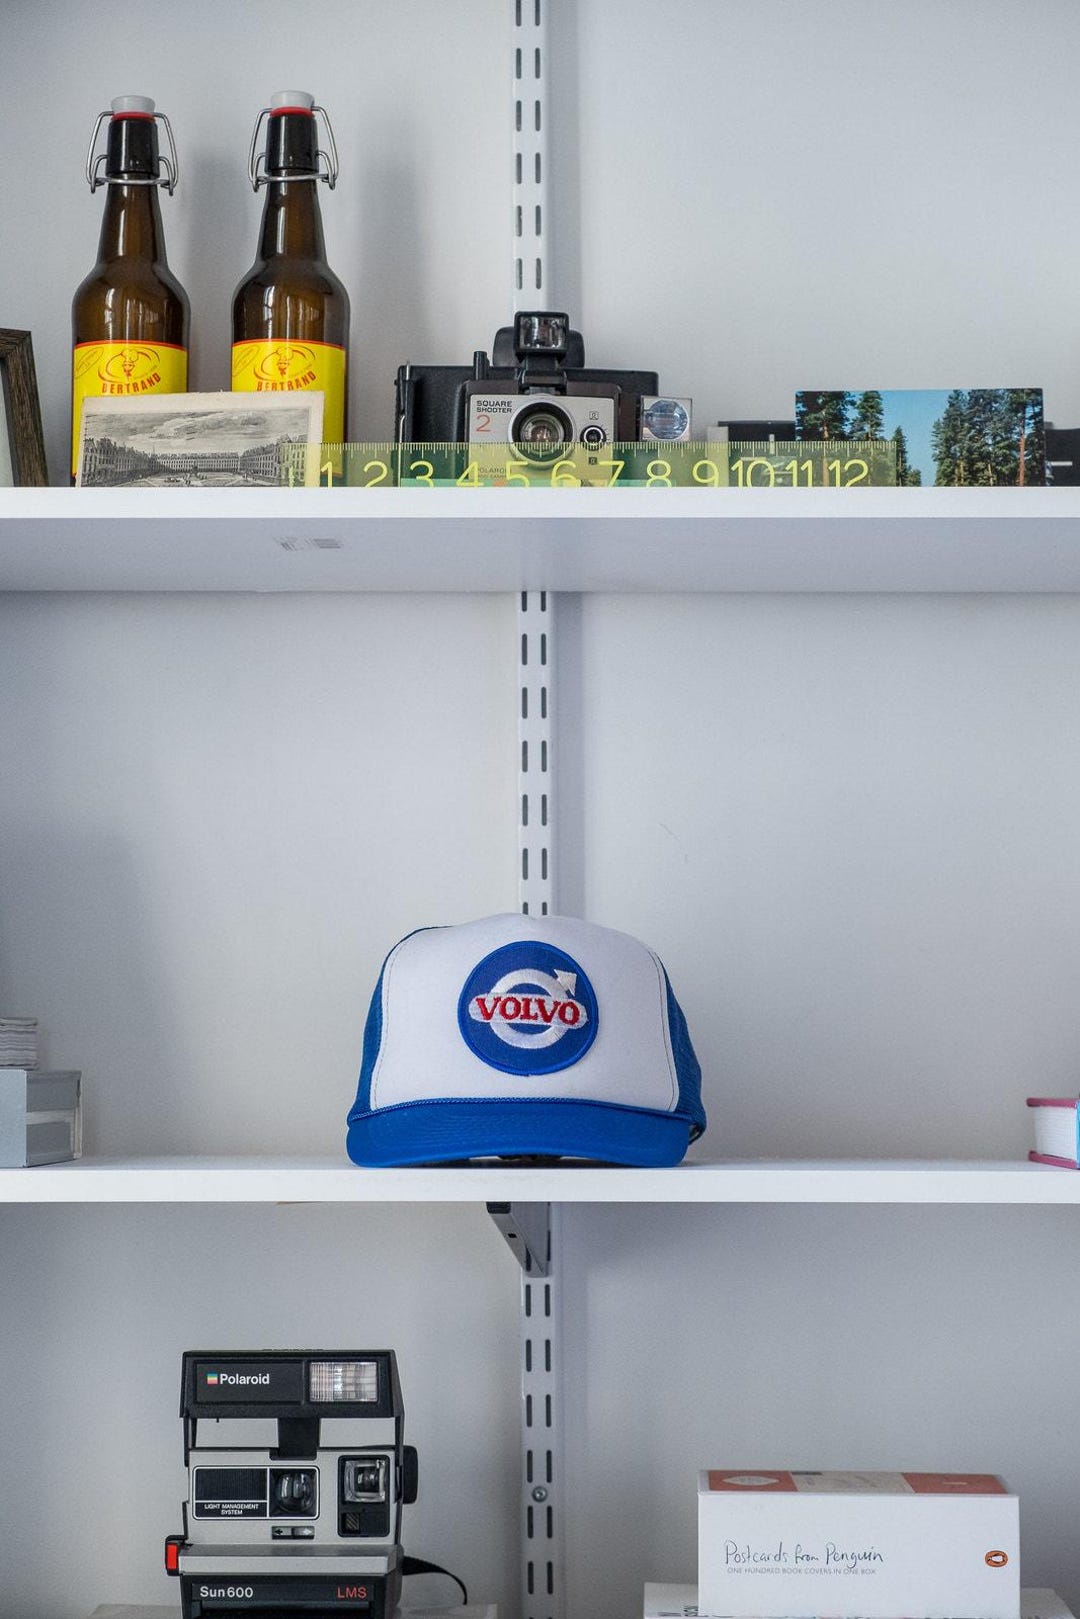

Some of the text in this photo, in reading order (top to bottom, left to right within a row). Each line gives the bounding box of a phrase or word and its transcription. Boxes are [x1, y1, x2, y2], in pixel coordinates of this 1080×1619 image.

[102, 372, 161, 394] BERTRAND
[256, 370, 317, 391] BERTRAND
[476, 414, 492, 432] 2
[320, 461, 333, 487] 1
[363, 460, 388, 487] 2
[409, 460, 435, 487] 3
[455, 460, 485, 487] 4
[505, 460, 531, 487] 5
[551, 460, 581, 487] 6
[598, 460, 625, 487] 7
[646, 459, 672, 487] 8
[692, 459, 720, 487] 9
[731, 459, 776, 487] 10
[785, 459, 813, 487] 11
[828, 459, 869, 487] 12
[475, 996, 581, 1026] VOLVO
[219, 1373, 270, 1385] Polaroid
[724, 1540, 884, 1569] Postcards from Penguin
[727, 1567, 877, 1575] ONE HUNDRED BOOK COVERS IN ONE BOX
[337, 1586, 367, 1599] LMS
